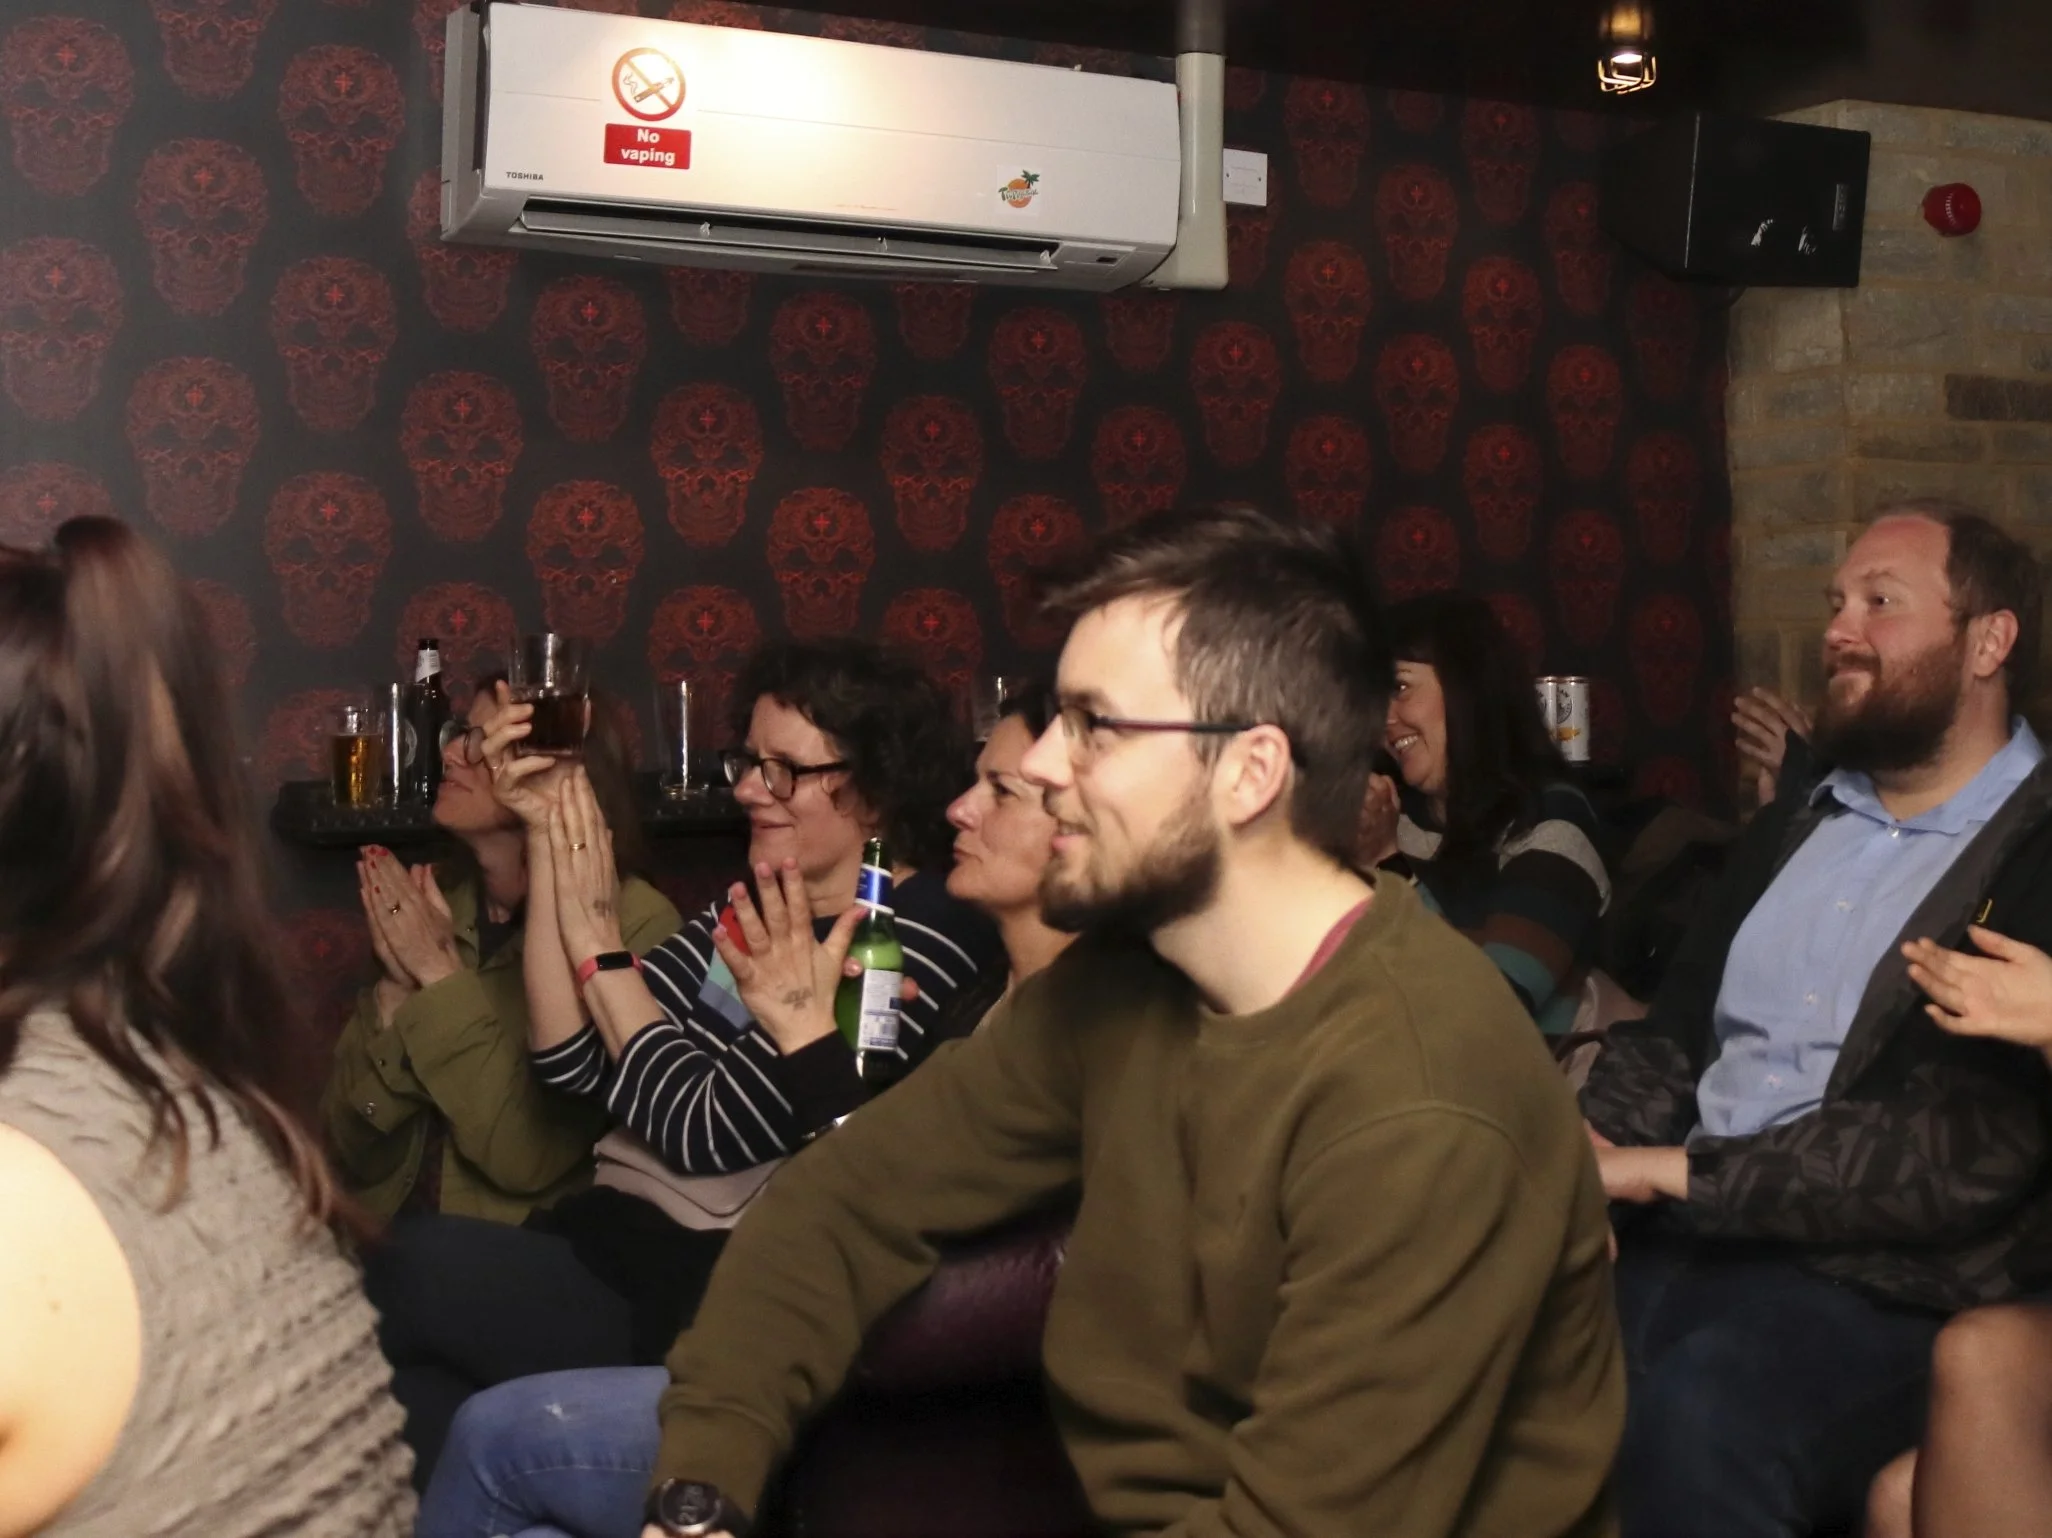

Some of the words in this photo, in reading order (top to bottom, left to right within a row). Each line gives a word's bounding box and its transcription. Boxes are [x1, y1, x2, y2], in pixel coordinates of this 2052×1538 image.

[637, 128, 659, 143] No
[621, 148, 675, 166] vaping
[506, 171, 544, 181] TOSHIBA
